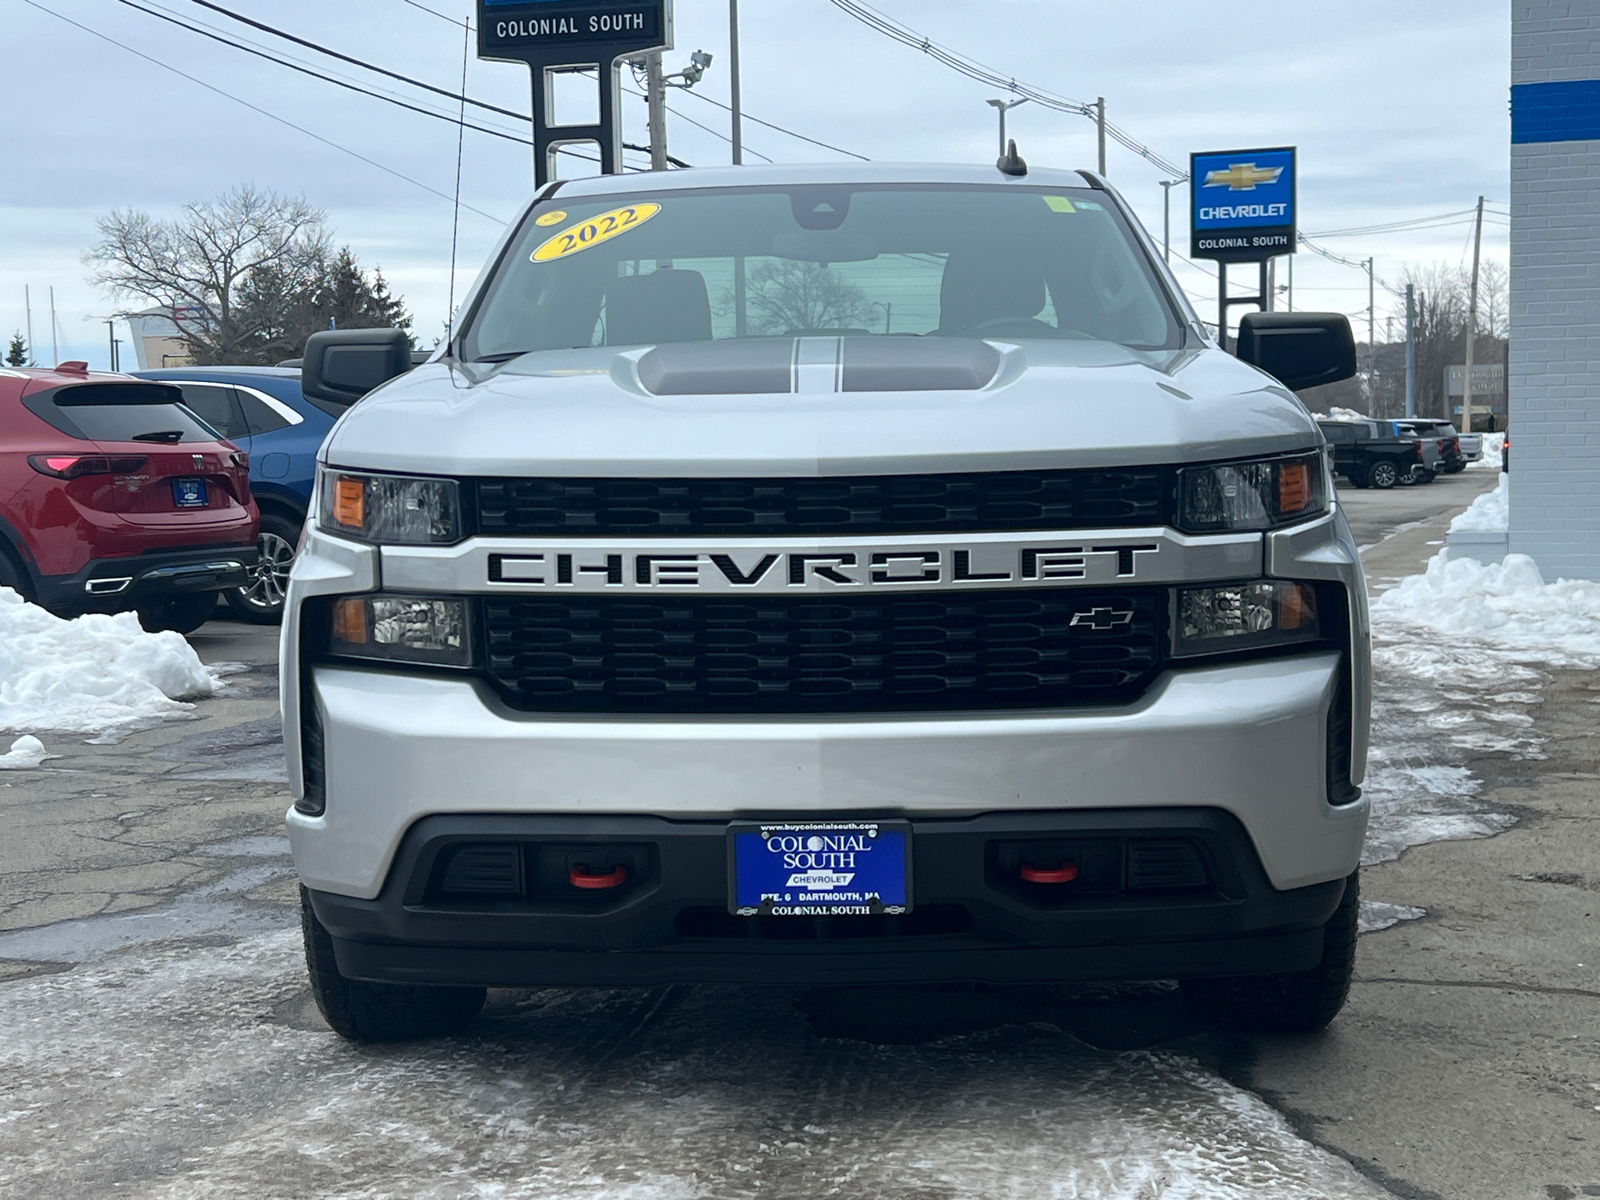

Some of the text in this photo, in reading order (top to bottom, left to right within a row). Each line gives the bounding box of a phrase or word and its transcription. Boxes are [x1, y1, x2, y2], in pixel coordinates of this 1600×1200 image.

[497, 13, 644, 38] COLONIAL SOUTH
[1200, 203, 1287, 219] CHEVROLET
[558, 208, 638, 254] 2022
[1199, 236, 1287, 249] COLONIAL SOUTH
[487, 543, 1159, 587] CHEVROLET
[761, 823, 878, 832] www.buycolonialsouth.com
[767, 836, 871, 852] COLONIAL
[783, 853, 855, 869] SOUTH
[793, 875, 848, 884] CHEVROLET
[785, 893, 792, 902] 6
[799, 893, 863, 902] DARTMOUTH,
[772, 906, 870, 915] COLONIAL SOUTH
